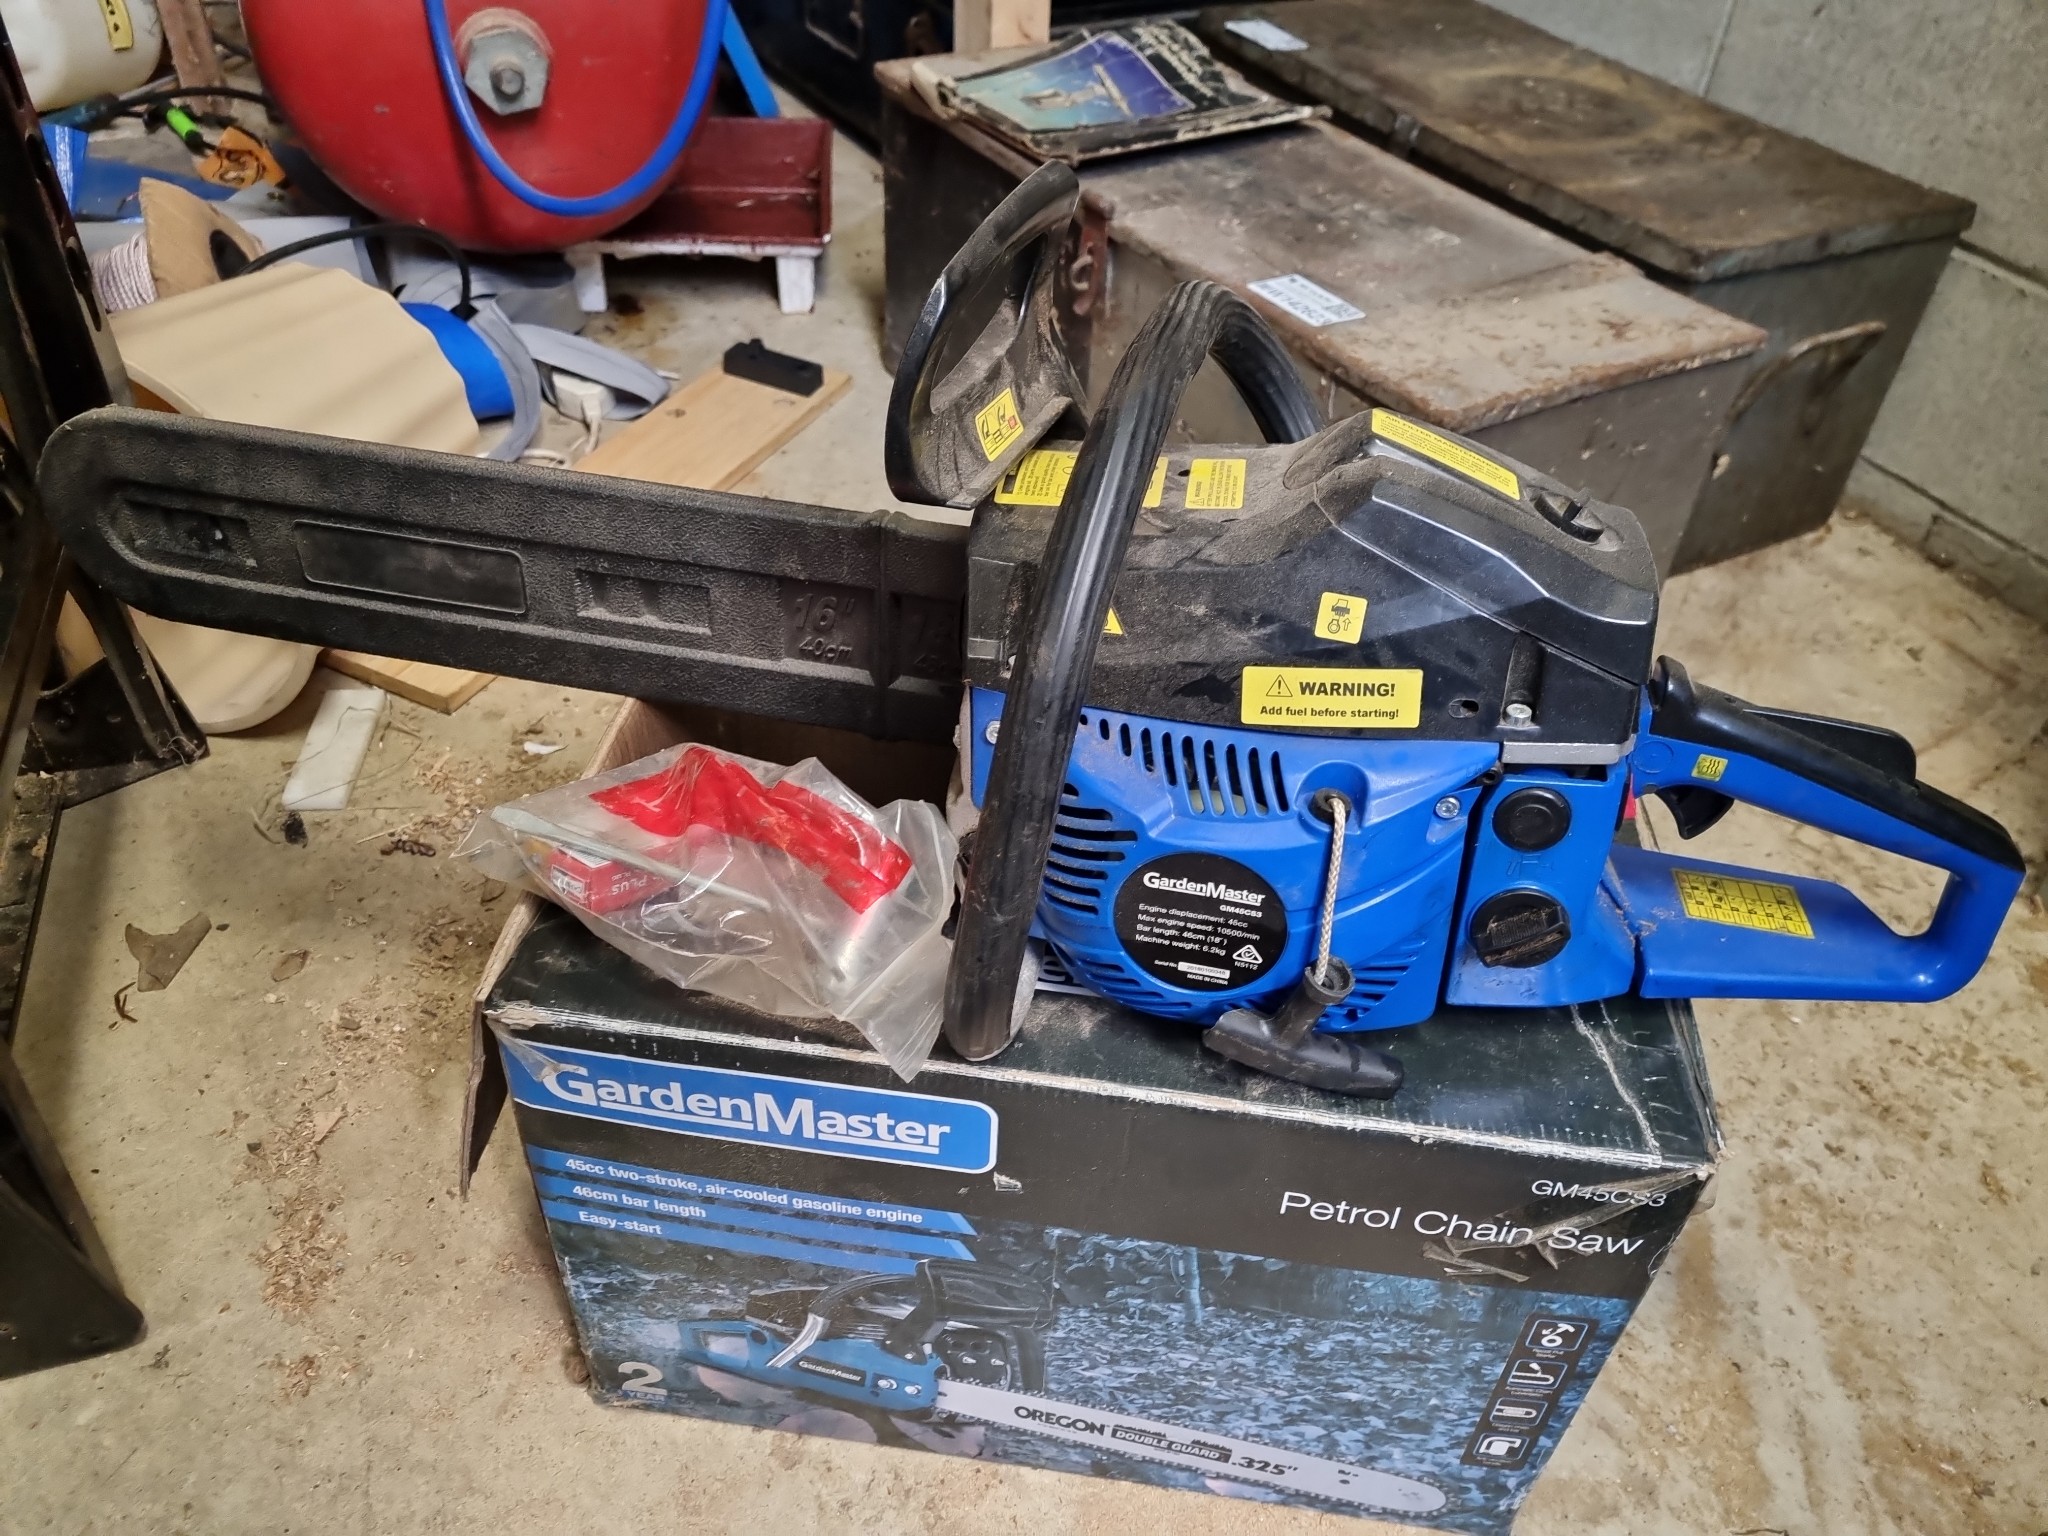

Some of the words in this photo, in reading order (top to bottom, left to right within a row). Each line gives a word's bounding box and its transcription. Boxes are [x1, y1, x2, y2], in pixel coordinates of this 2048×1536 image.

[1299, 681, 1396, 698] WARNING!
[1260, 705, 1283, 716] Add
[1286, 706, 1307, 717] fuel
[1310, 707, 1347, 718] before
[1350, 708, 1400, 720] starting!
[1142, 871, 1266, 904] GardenMaster
[1137, 913, 1156, 923] Max
[1157, 916, 1186, 927] engine
[1186, 922, 1215, 933] speed:
[1217, 926, 1261, 941] 10500/min
[1138, 903, 1168, 914] Engine
[1168, 907, 1226, 924] displacement:
[1136, 923, 1152, 932] Bar
[1153, 926, 1180, 937] length:
[1135, 933, 1171, 945] Machine
[1171, 939, 1201, 951] weight:
[1202, 945, 1227, 957] 6.2kg
[1186, 973, 1204, 981] MADE
[1210, 977, 1229, 985] CHINA
[541, 1063, 952, 1150] GardenMaster
[565, 1157, 605, 1175] 45cc
[607, 1164, 703, 1194] two-stroke,
[705, 1183, 788, 1206] air-cooled
[792, 1195, 863, 1216] gasoline
[865, 1207, 923, 1224] engine
[572, 1184, 618, 1203] 46cm
[621, 1193, 650, 1209] bar
[653, 1197, 707, 1219] length
[1531, 1179, 1668, 1208] GM45CS3
[578, 1210, 663, 1236] Easy-start
[1278, 1190, 1402, 1230] Petrol
[1412, 1209, 1534, 1246] Chain
[1547, 1226, 1645, 1256] Saw
[617, 1361, 668, 1396] 2
[1013, 1405, 1106, 1437] OREGON
[1114, 1430, 1170, 1450] DOUBLE
[1171, 1442, 1221, 1460] GUARD
[1230, 1455, 1299, 1477] .325"
